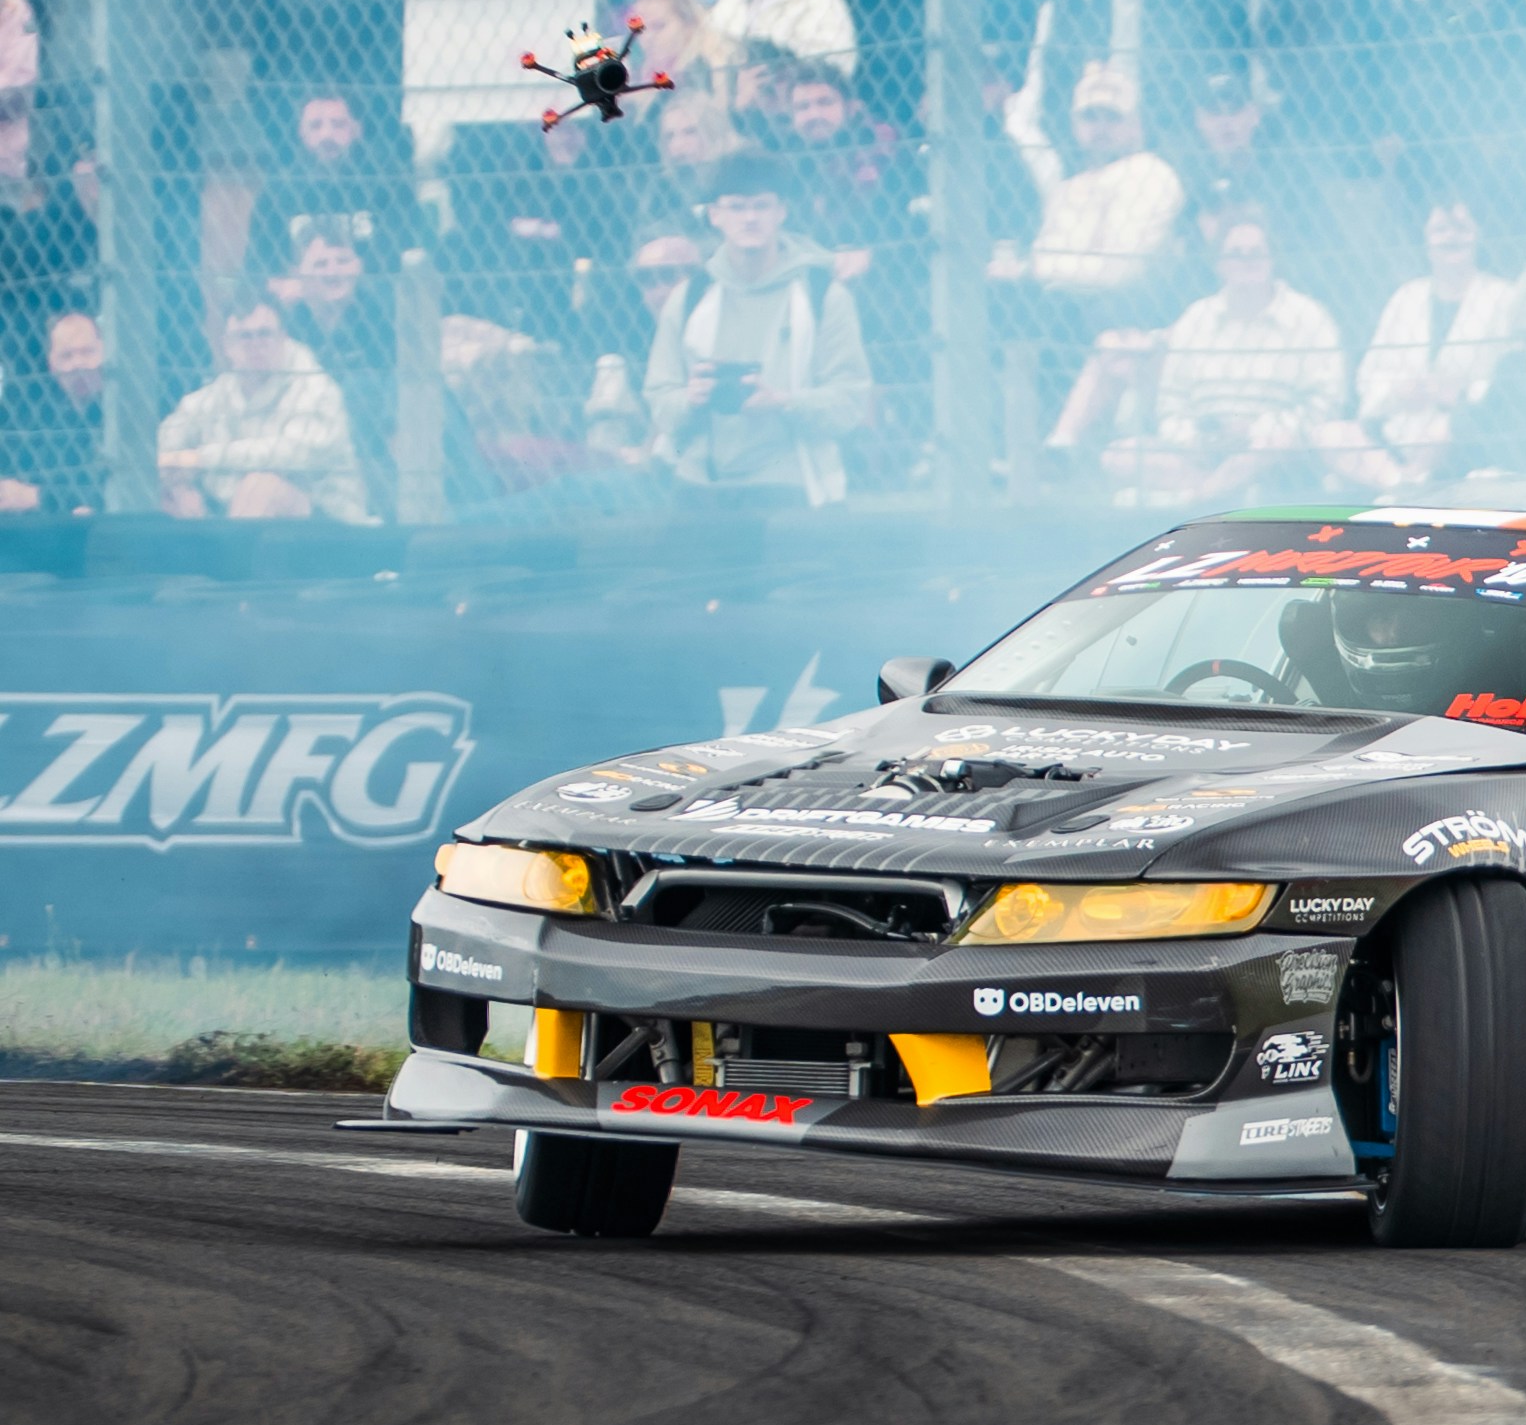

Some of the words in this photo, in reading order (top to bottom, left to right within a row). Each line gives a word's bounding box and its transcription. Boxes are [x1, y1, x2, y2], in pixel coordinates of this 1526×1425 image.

[0, 712, 455, 830] ZMFG
[983, 837, 1156, 851] EXEMPLAR
[1447, 838, 1511, 859] WHEELS
[1295, 912, 1365, 923] COMPETITIONS
[436, 950, 503, 981] OBDeleven
[1009, 991, 1141, 1013] OBDeleven
[1274, 1061, 1323, 1080] LINK
[610, 1085, 814, 1126] SONAX
[1242, 1123, 1289, 1141] TIRE
